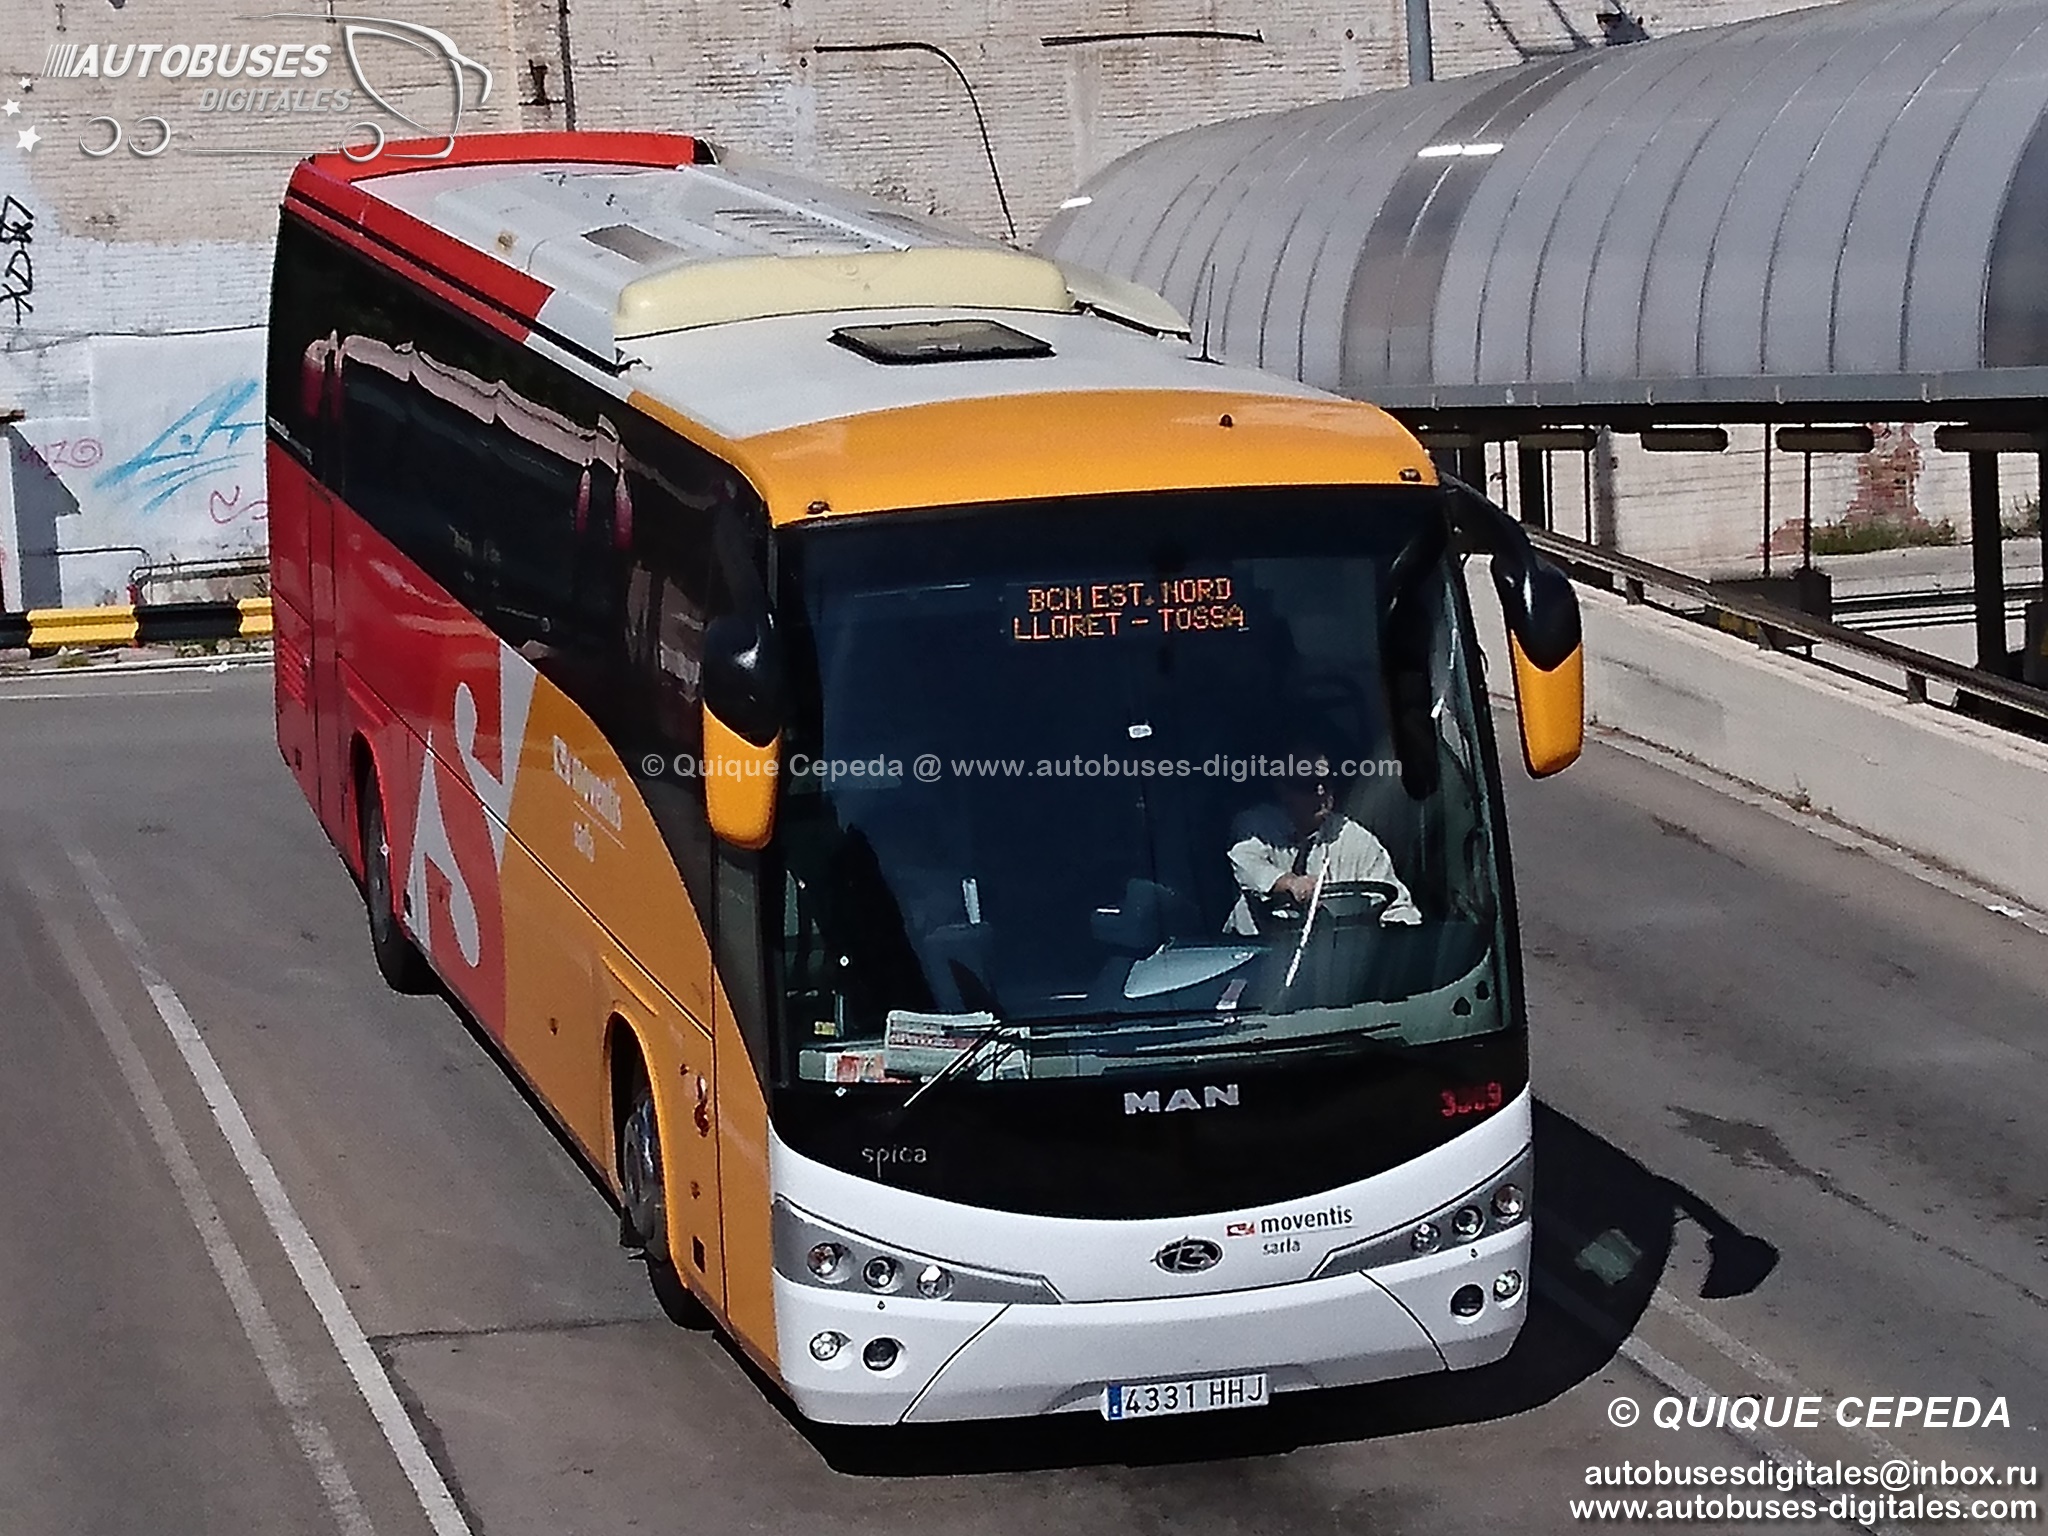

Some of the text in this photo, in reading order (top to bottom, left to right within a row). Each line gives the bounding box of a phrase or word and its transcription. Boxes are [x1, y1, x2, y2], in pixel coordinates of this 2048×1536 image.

[1091, 582, 1155, 609] EST.
[1160, 577, 1231, 604] NORD
[1013, 612, 1122, 640] LLORET
[1158, 604, 1244, 633] TOSSA
[1123, 1083, 1240, 1116] MAN
[861, 1145, 928, 1179] spica
[1261, 1205, 1354, 1234] moventis
[1125, 1375, 1263, 1414] 4331 HHJ
